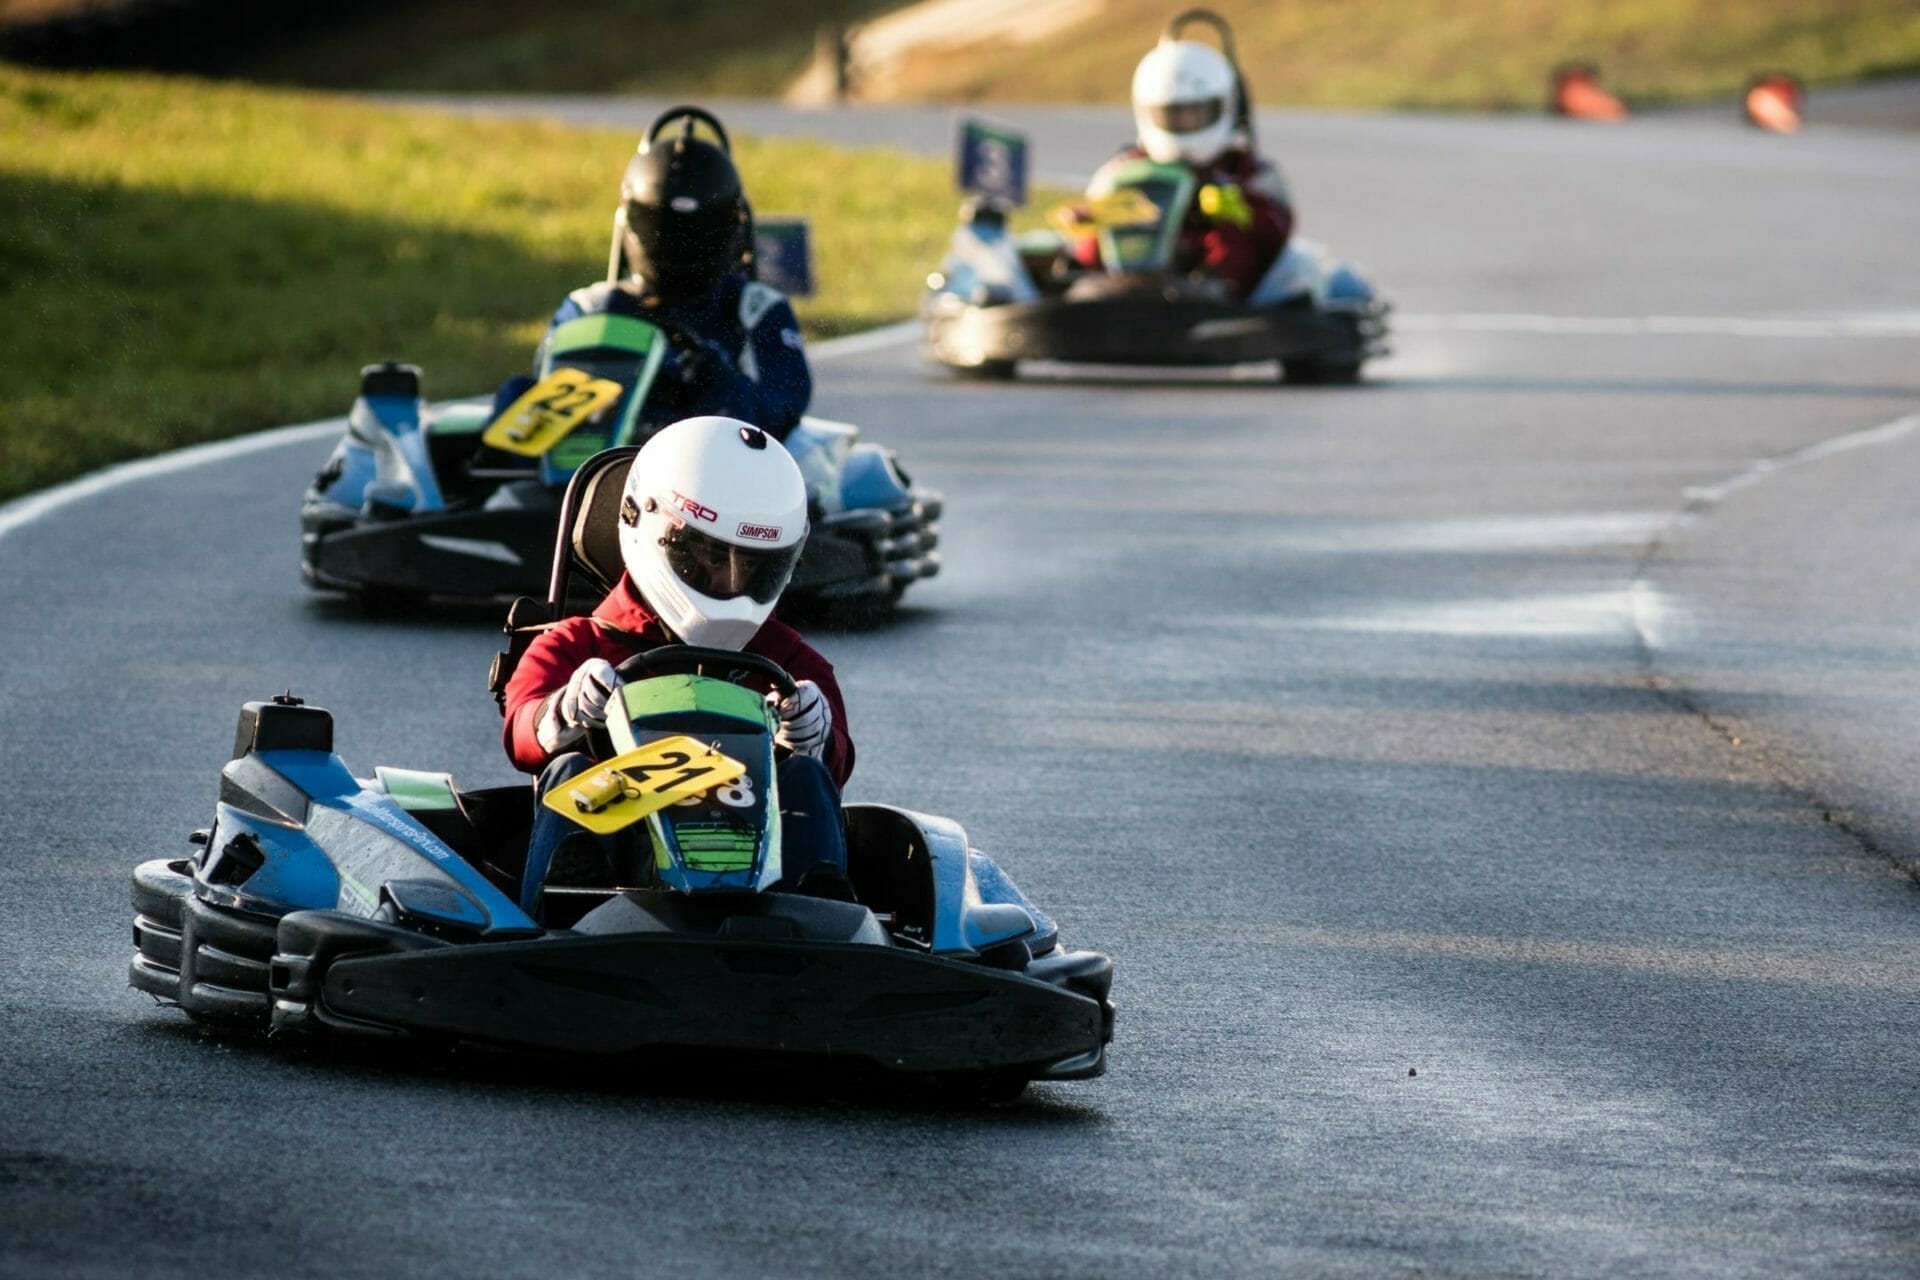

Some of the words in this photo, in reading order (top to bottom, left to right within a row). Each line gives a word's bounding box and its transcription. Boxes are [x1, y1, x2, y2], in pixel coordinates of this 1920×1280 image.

[535, 383, 597, 417] 22
[672, 489, 718, 522] TRD
[740, 525, 780, 539] SIMPSON
[620, 751, 715, 793] 21
